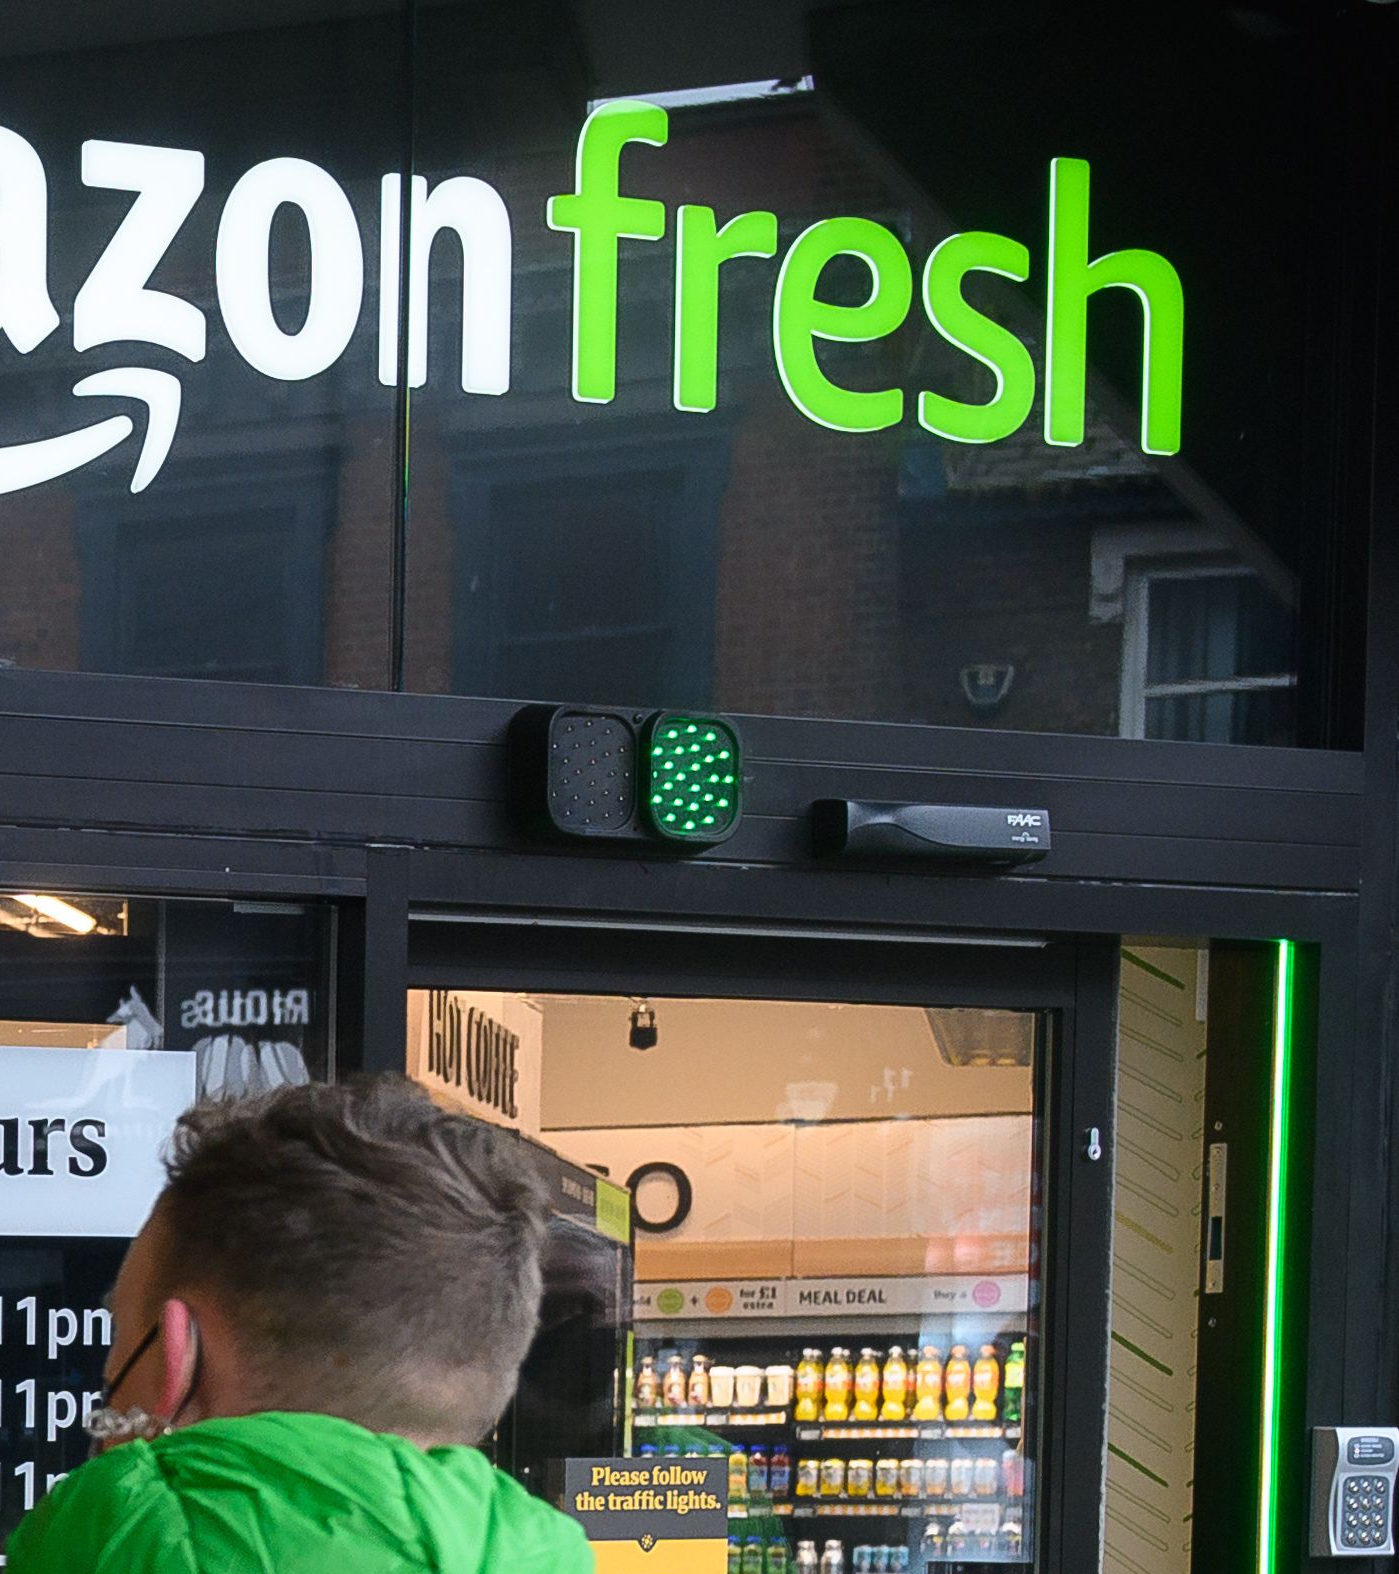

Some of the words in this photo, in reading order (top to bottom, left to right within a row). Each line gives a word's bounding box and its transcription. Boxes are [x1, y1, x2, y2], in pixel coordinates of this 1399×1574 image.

[547, 100, 1184, 456] fresh
[1007, 813, 1041, 827] FAAC
[799, 1290, 843, 1307] MEAL
[846, 1289, 888, 1306] DEAL
[591, 1466, 649, 1487] Please
[652, 1466, 707, 1486] follow
[575, 1492, 605, 1511] the
[608, 1490, 664, 1511] traffic
[666, 1490, 721, 1514] lights.
